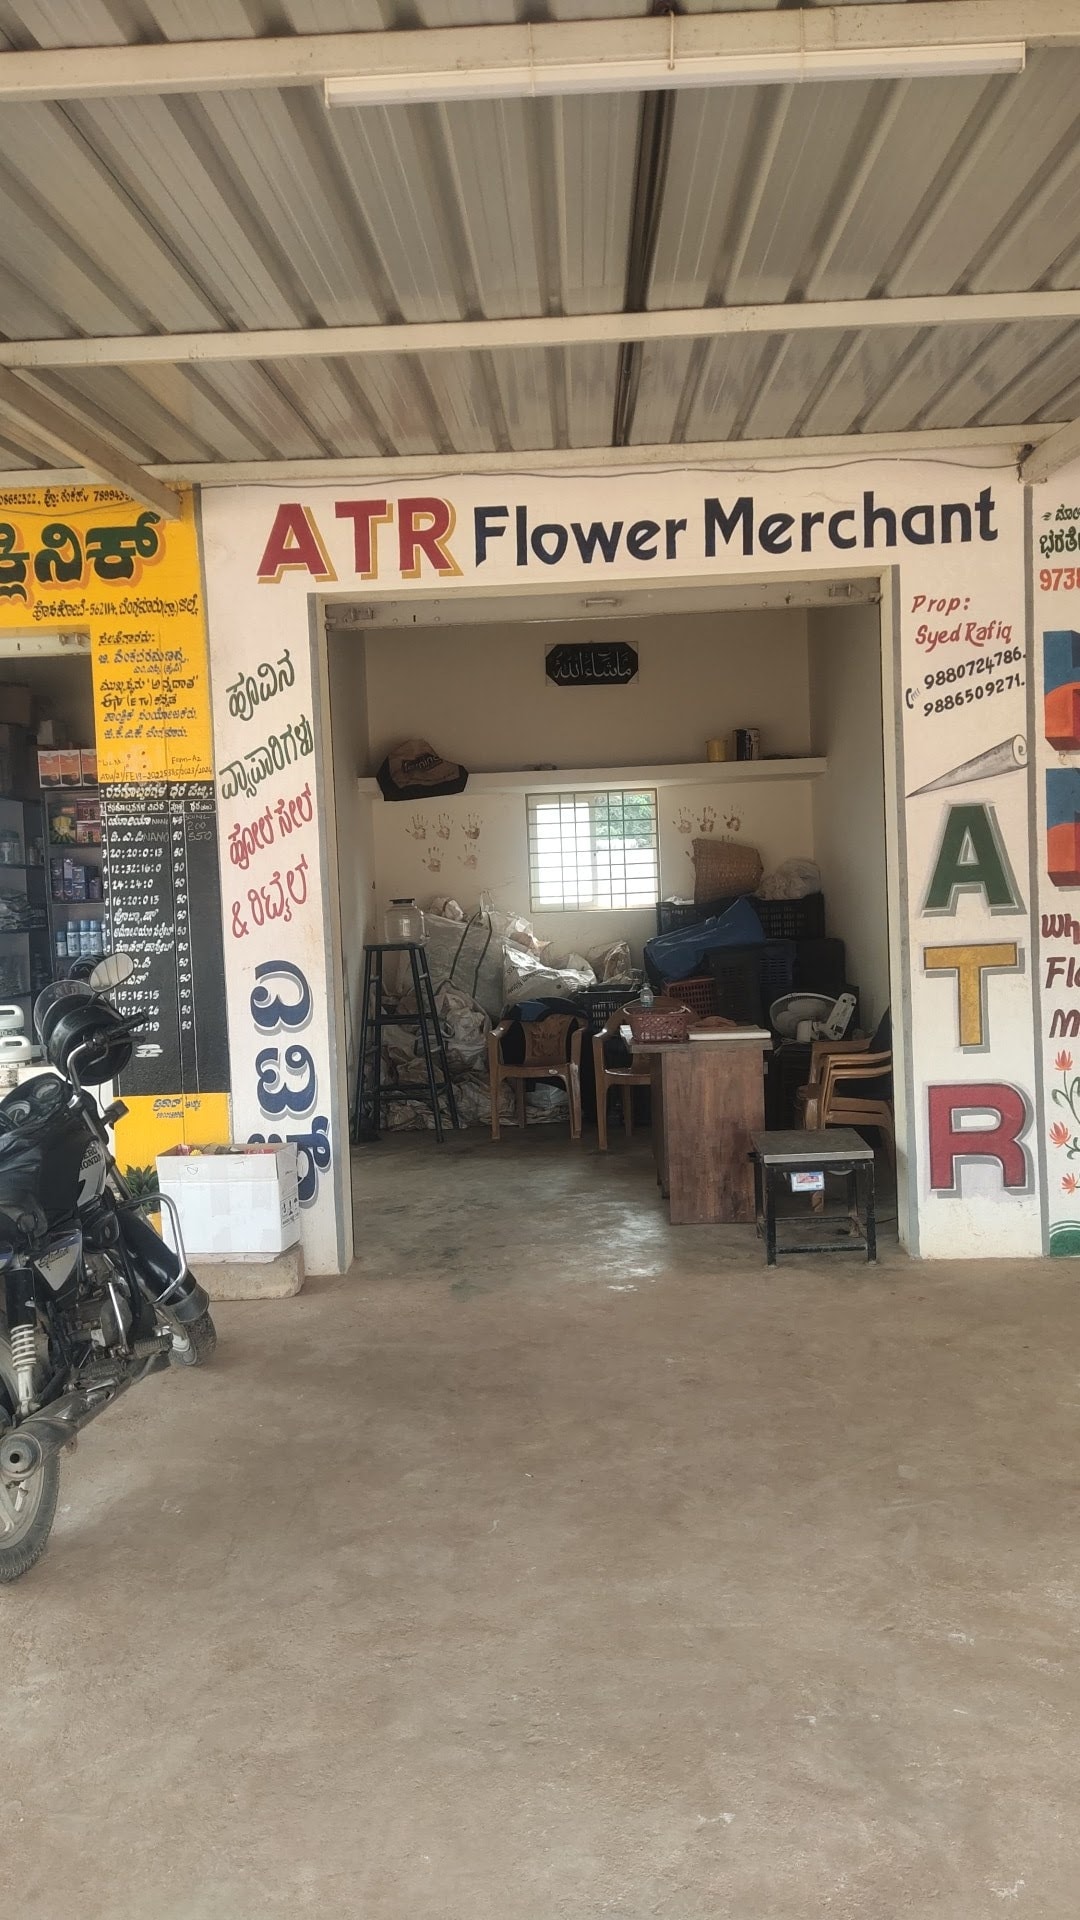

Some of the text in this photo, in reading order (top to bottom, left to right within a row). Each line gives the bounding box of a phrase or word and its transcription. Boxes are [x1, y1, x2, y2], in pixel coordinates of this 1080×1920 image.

[256, 486, 999, 584] ATR Flower Merchant
[911, 595, 971, 616] Prop:
[915, 620, 1012, 653] Syed Rafiq
[226, 649, 295, 721] ಹೂವಿನ
[219, 714, 314, 800] ವ್ಯಾಪಾರಿಗಳು
[228, 782, 313, 870] ಹೋಲ್ ಸೇಲ್
[231, 901, 249, 938] &
